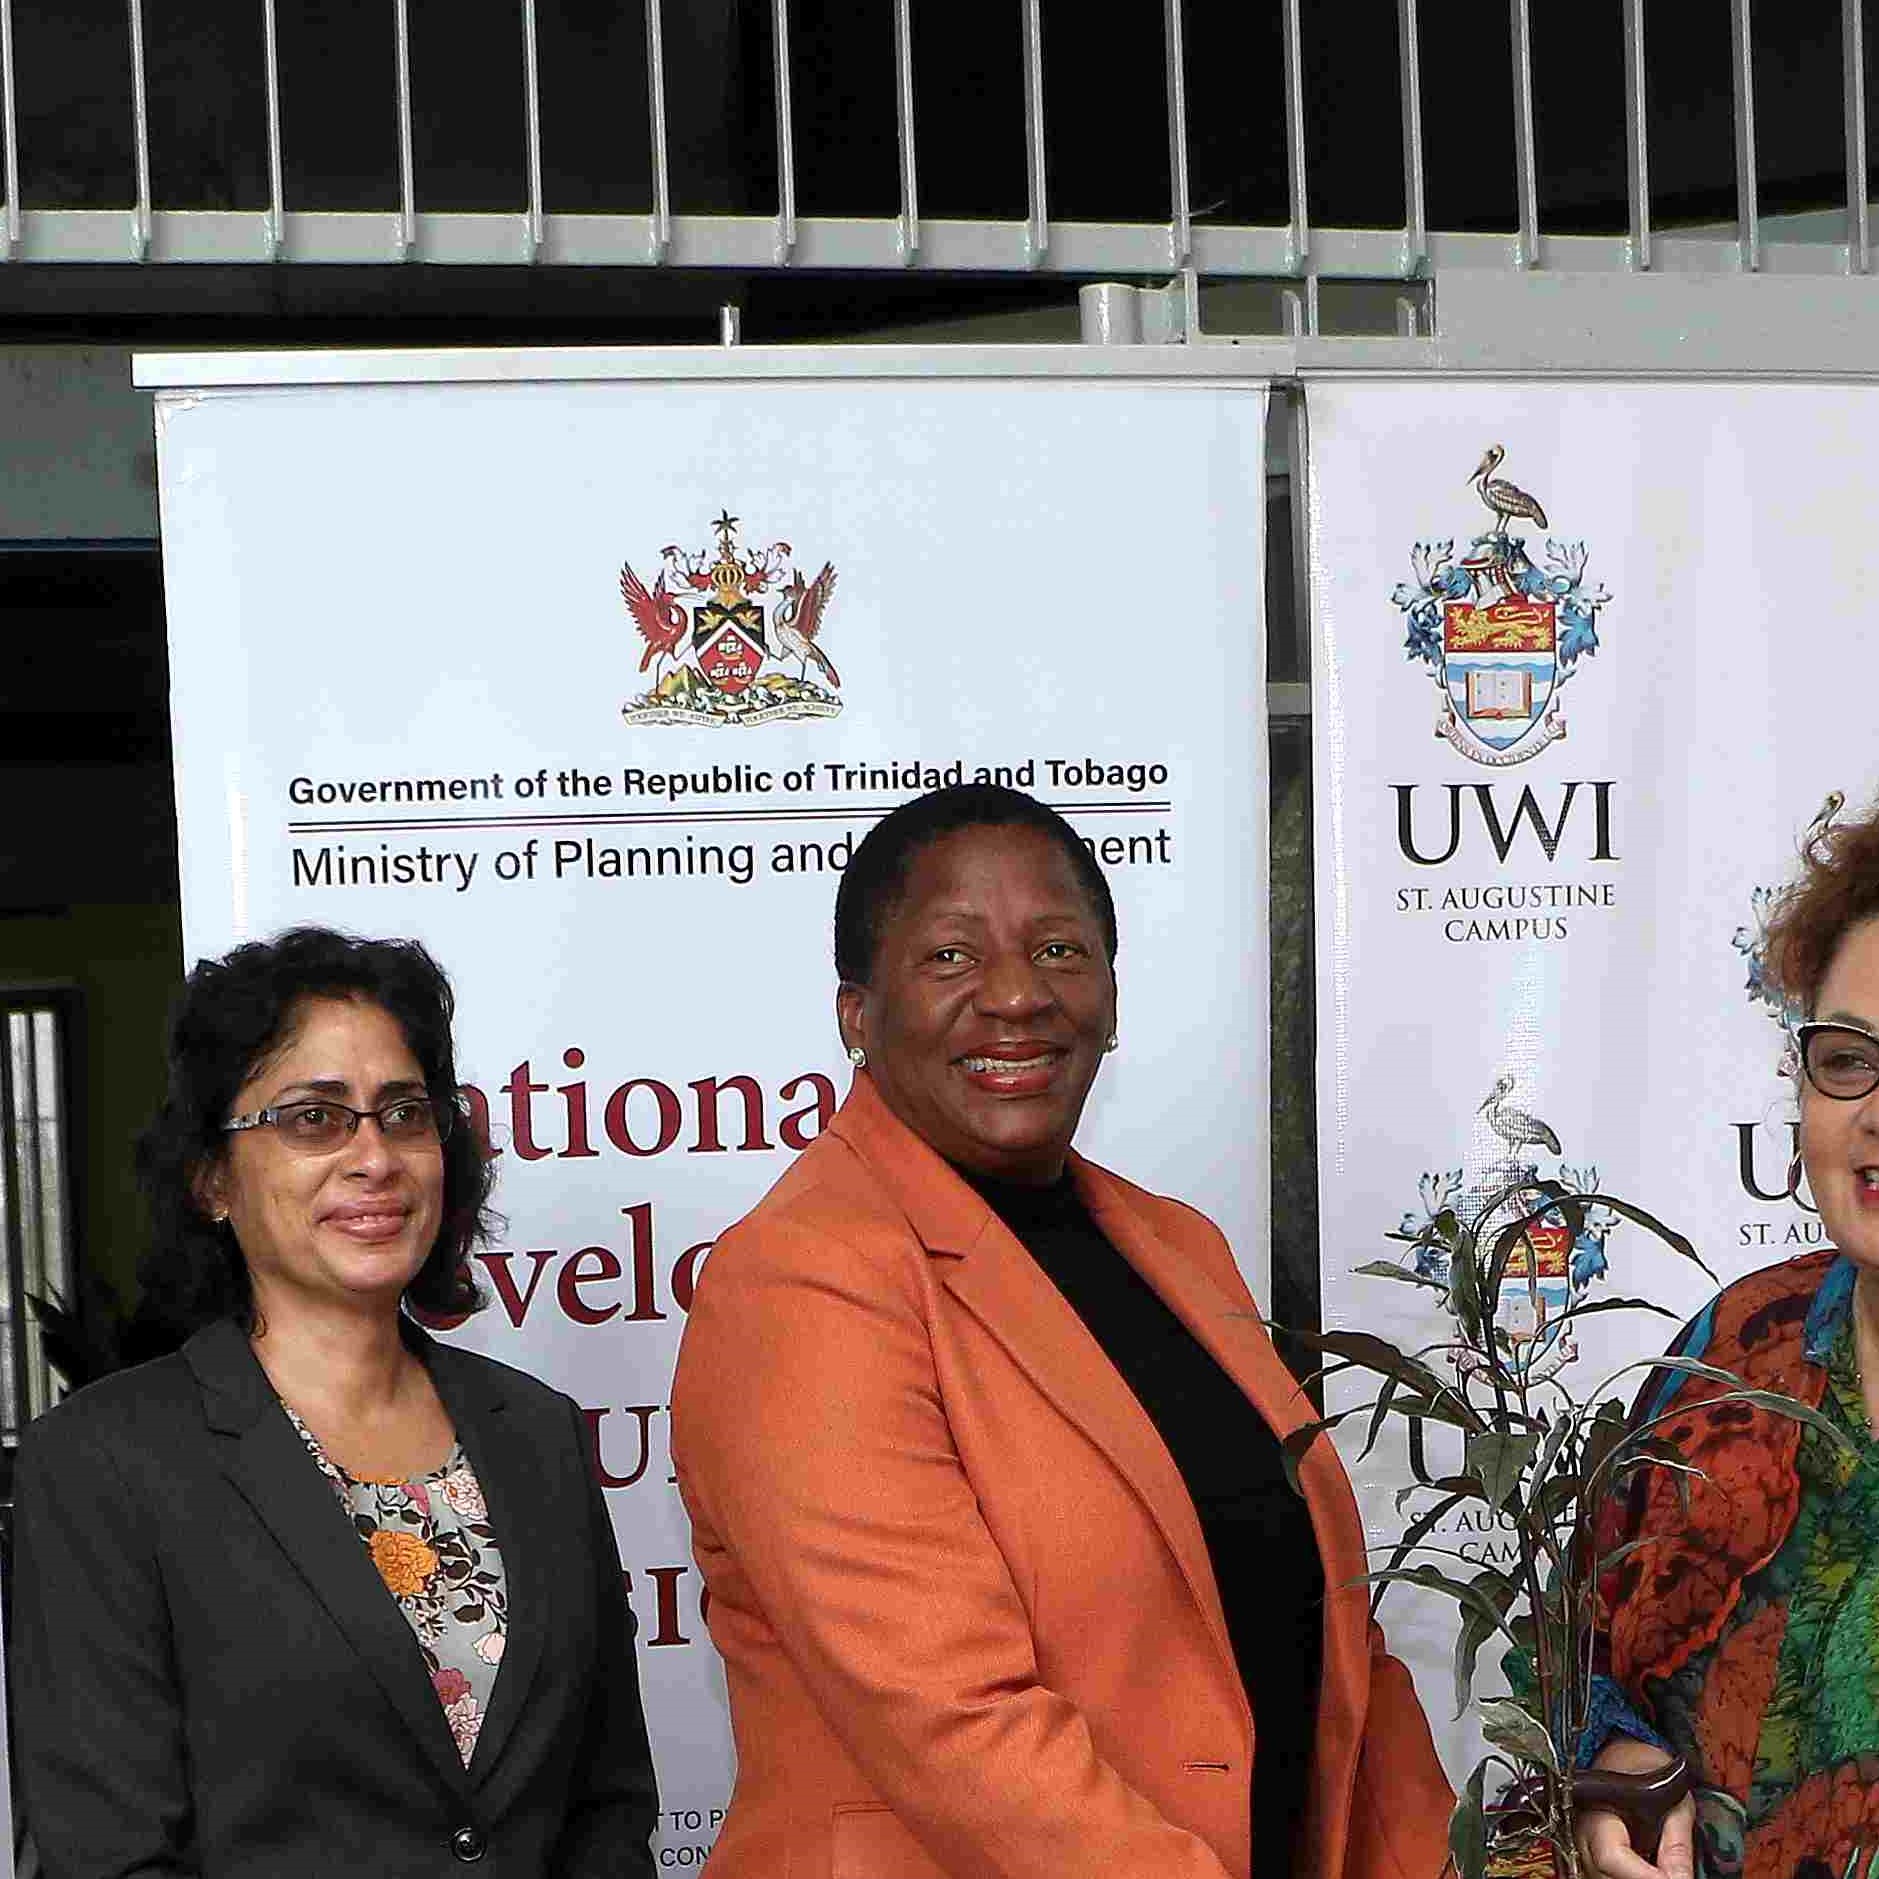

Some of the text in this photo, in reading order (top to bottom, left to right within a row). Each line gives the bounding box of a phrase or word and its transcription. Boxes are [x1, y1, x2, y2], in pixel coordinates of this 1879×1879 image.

[289, 758, 1169, 805] Government of the Republic of Trinidad and Tobago
[1387, 781, 1622, 866] UWI
[292, 830, 853, 893] Ministry of Planning and
[1396, 883, 1616, 911] ST. AUGUSTINE
[1444, 917, 1568, 942] CAMPUS
[1738, 1223, 1776, 1246] ST.
[670, 1810, 702, 1831] TO
